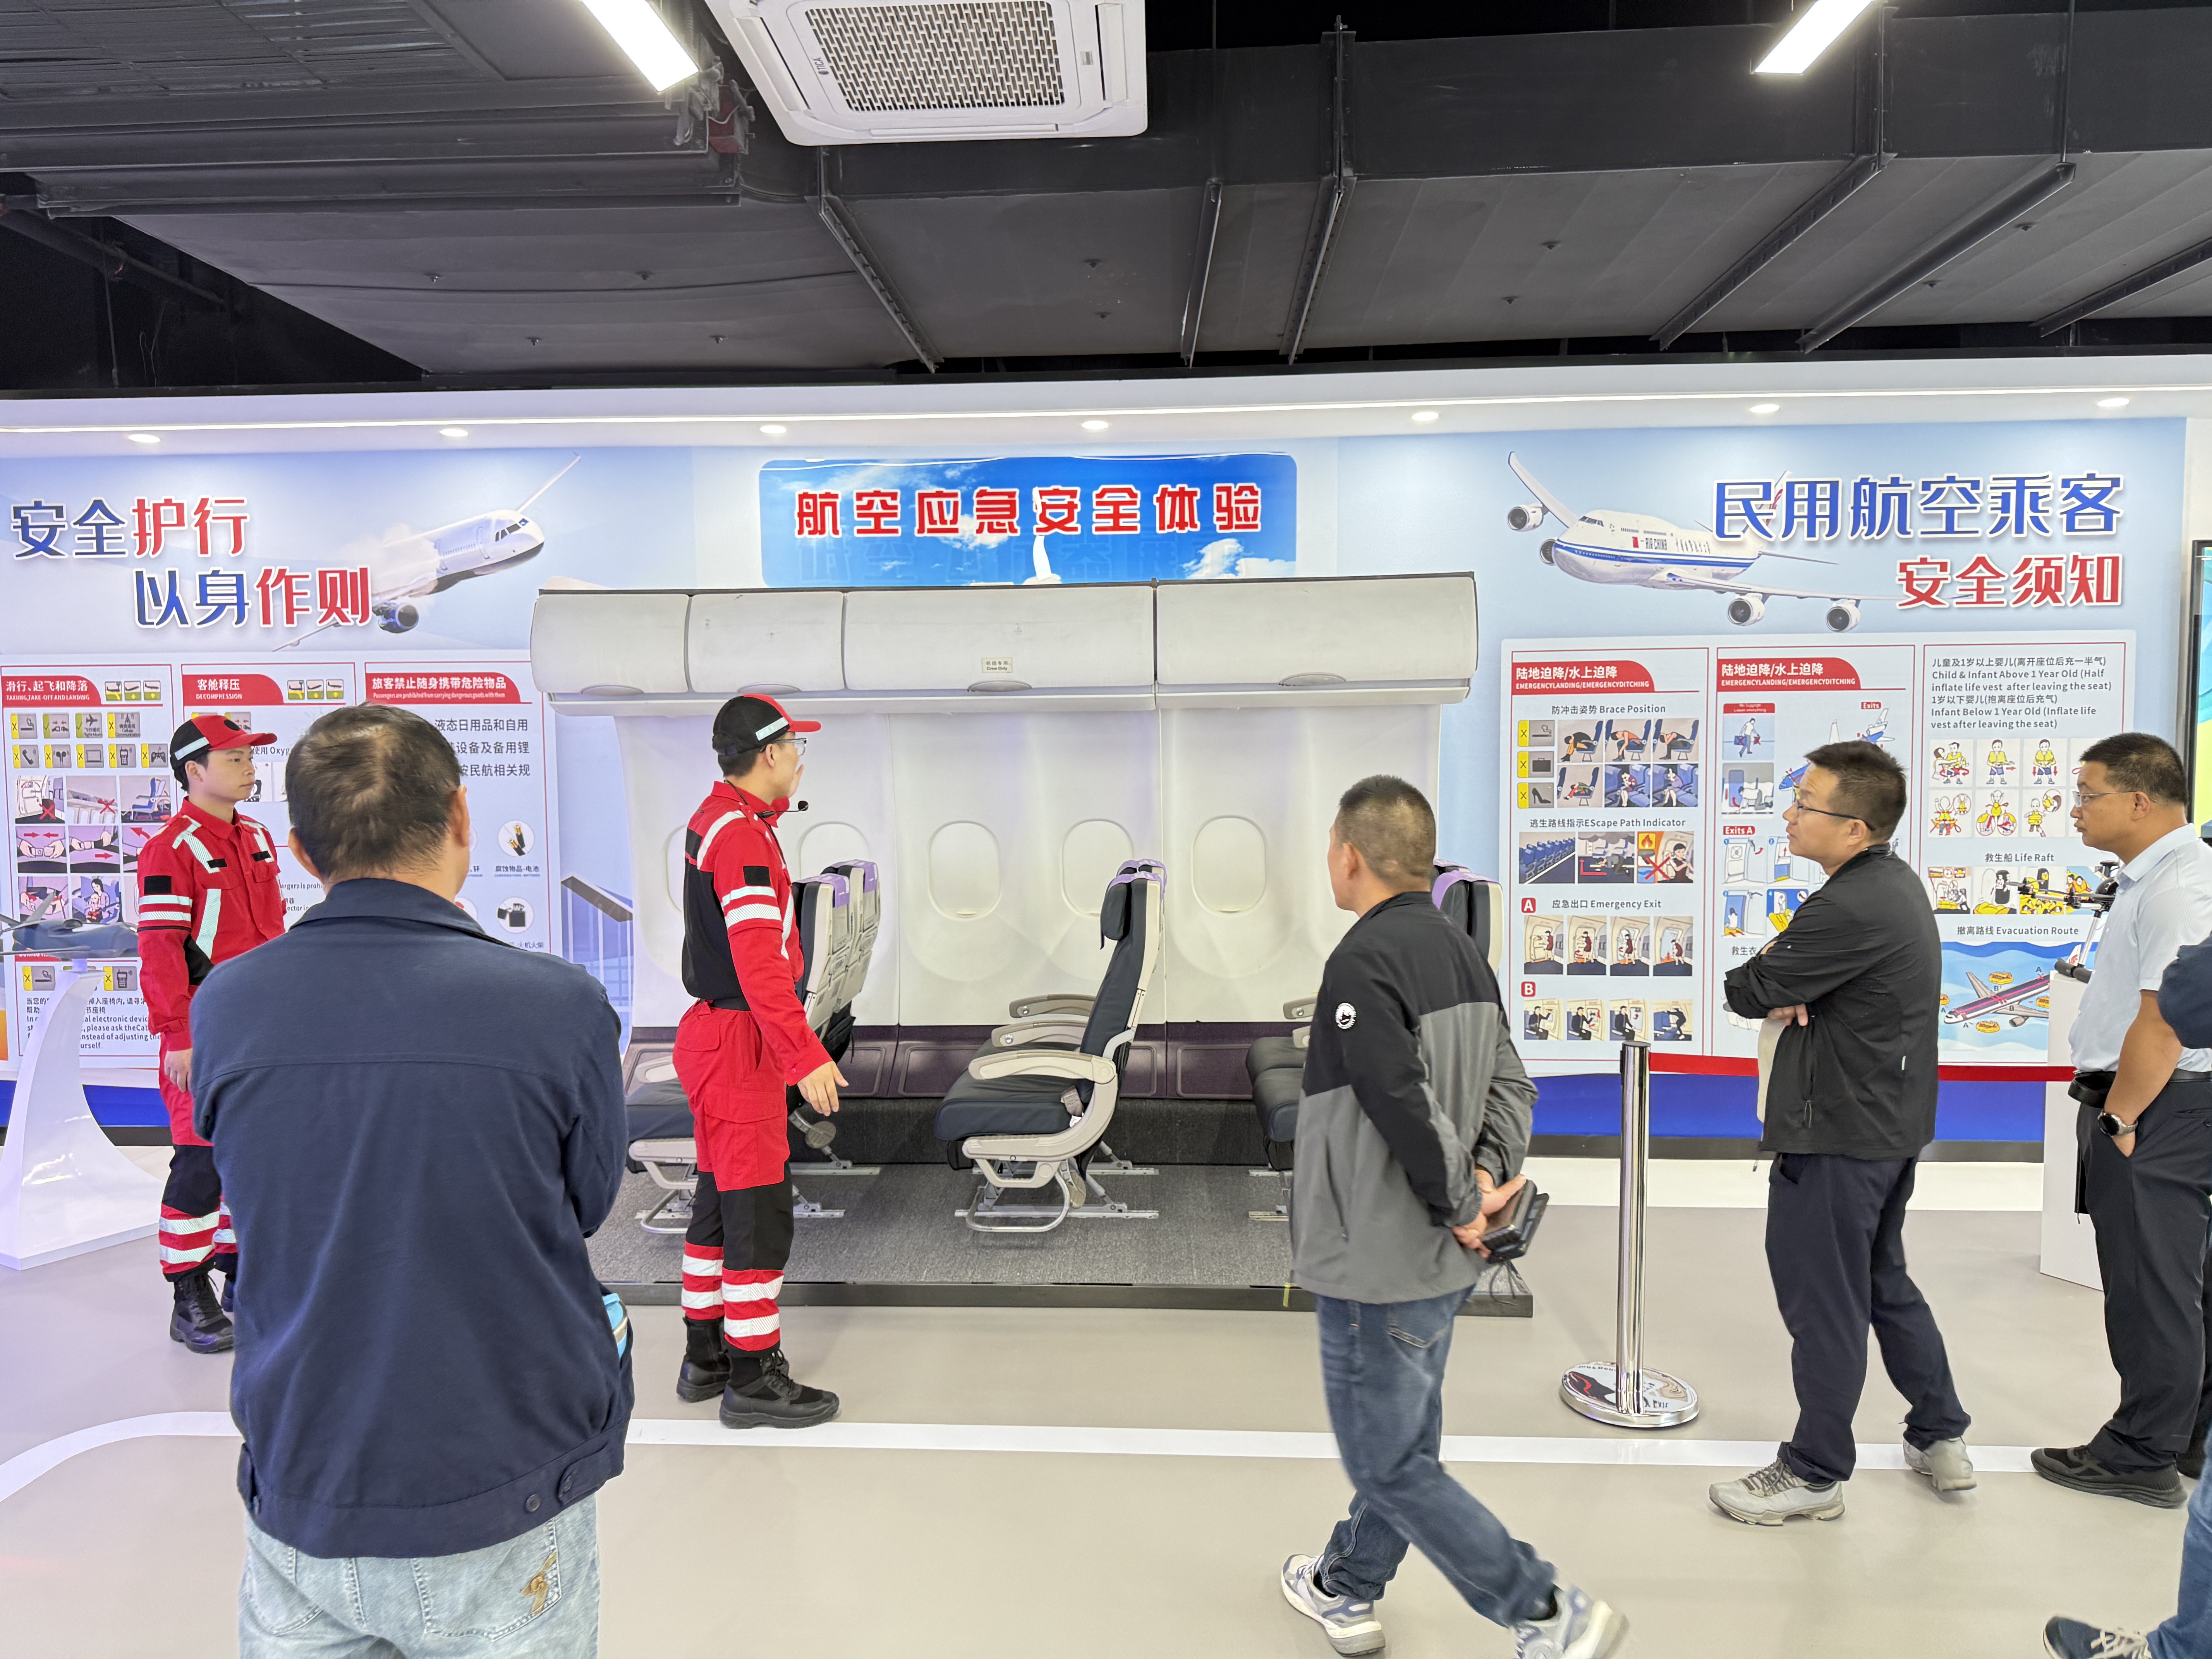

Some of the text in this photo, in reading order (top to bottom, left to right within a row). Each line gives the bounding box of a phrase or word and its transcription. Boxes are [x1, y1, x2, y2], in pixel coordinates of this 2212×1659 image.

[813, 57, 826, 70] TICA
[795, 483, 1262, 538] 航空应急安全体验
[1713, 472, 2124, 541] 民用航空乘客
[10, 498, 250, 558] 安全护行
[1896, 554, 2123, 609] 安全须知
[134, 567, 372, 628] 以身作则
[1516, 665, 1618, 680] 陆地迫降/水上迫降
[1721, 663, 1824, 677] 陆地迫降/水上迫降
[1932, 671, 1957, 679] Child
[1968, 670, 1997, 678] Infant
[1999, 670, 2029, 678] Above
[2038, 670, 2059, 678] Year
[2061, 669, 2078, 678] Old
[2080, 669, 2105, 678] (Half
[6, 680, 88, 692] 滑行、起飞和降落
[197, 678, 240, 691] 客舱释压
[372, 677, 506, 689] 旅客禁止随身携带危险物品
[1932, 684, 1963, 692] inflate
[1965, 683, 1980, 691] life
[2006, 683, 2030, 691] after
[2032, 682, 2068, 692] leaving
[2087, 681, 2112, 691] seat)
[1932, 694, 2057, 705] 1岁以下婴儿(抱离座位后充气)
[1551, 705, 1597, 715] 防冲击姿势
[1627, 704, 1666, 713] Position
[1931, 708, 1961, 716] Infant
[1963, 708, 1992, 716] Below
[2025, 707, 2041, 715] Old
[2043, 707, 2078, 716] (Inflate
[2080, 707, 2096, 715] life
[1953, 720, 1977, 728] after
[1979, 720, 2014, 730] leaving
[2033, 719, 2057, 729] seat)
[1620, 818, 1641, 827] Path
[1643, 818, 1686, 827] Indicator
[1985, 853, 2054, 863] 救生船 Life Raft
[1524, 900, 1534, 911] A
[1552, 900, 1662, 909] 应急出口 Emergency Exit
[1957, 926, 2079, 936] 撤离路线 Evacuation Route
[1524, 983, 1534, 995] B
[87, 1024, 109, 1032] please
[115, 1033, 148, 1041] adjusting
